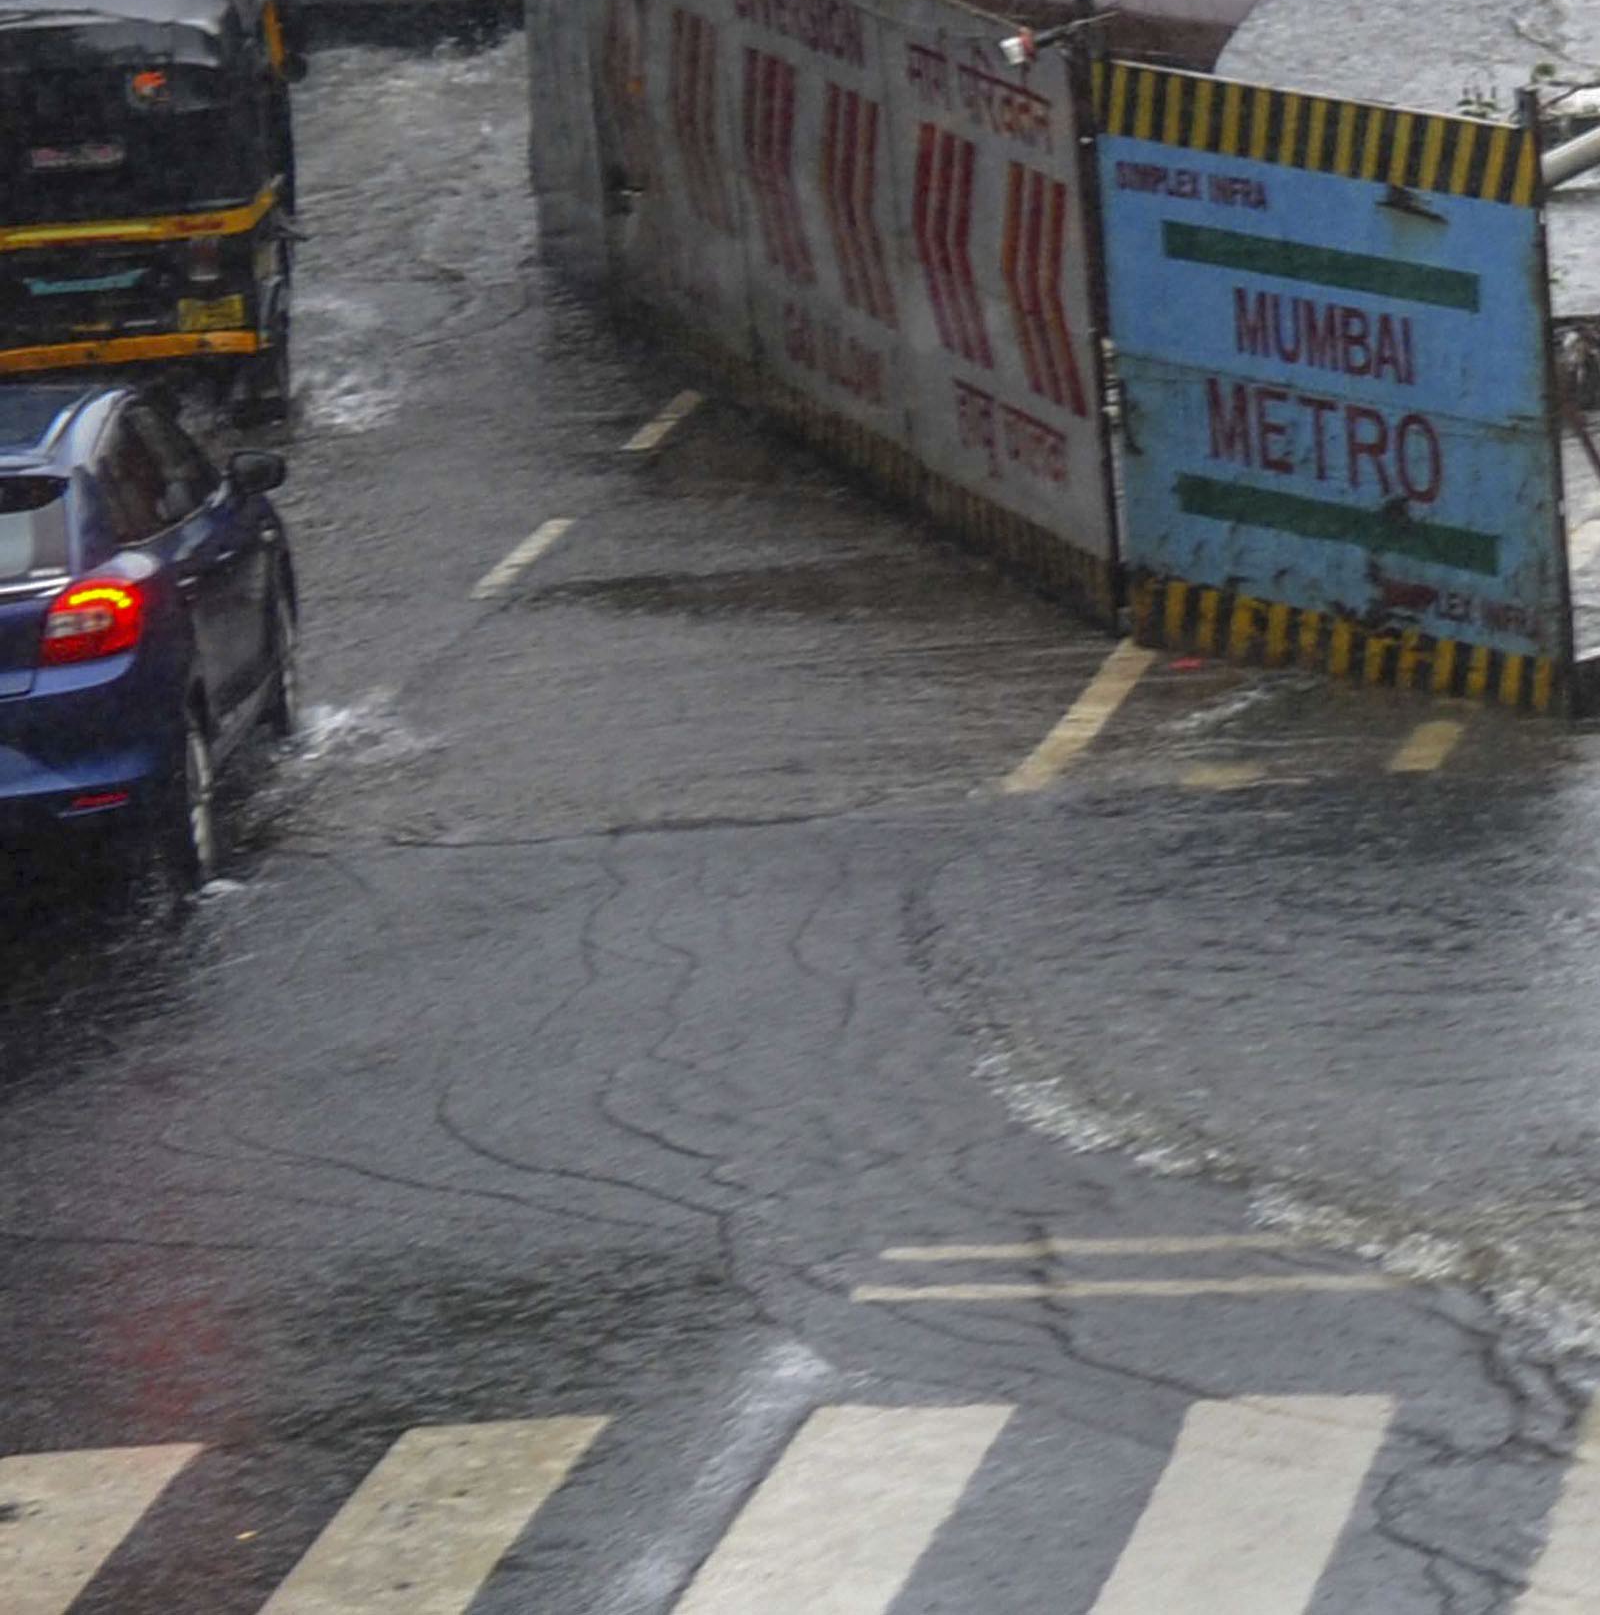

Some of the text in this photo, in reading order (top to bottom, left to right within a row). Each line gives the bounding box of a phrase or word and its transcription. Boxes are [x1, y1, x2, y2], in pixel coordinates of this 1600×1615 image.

[1208, 174, 1268, 211] INFRA
[1234, 286, 1416, 386] MUMBAI
[1205, 377, 1443, 504] METRO
